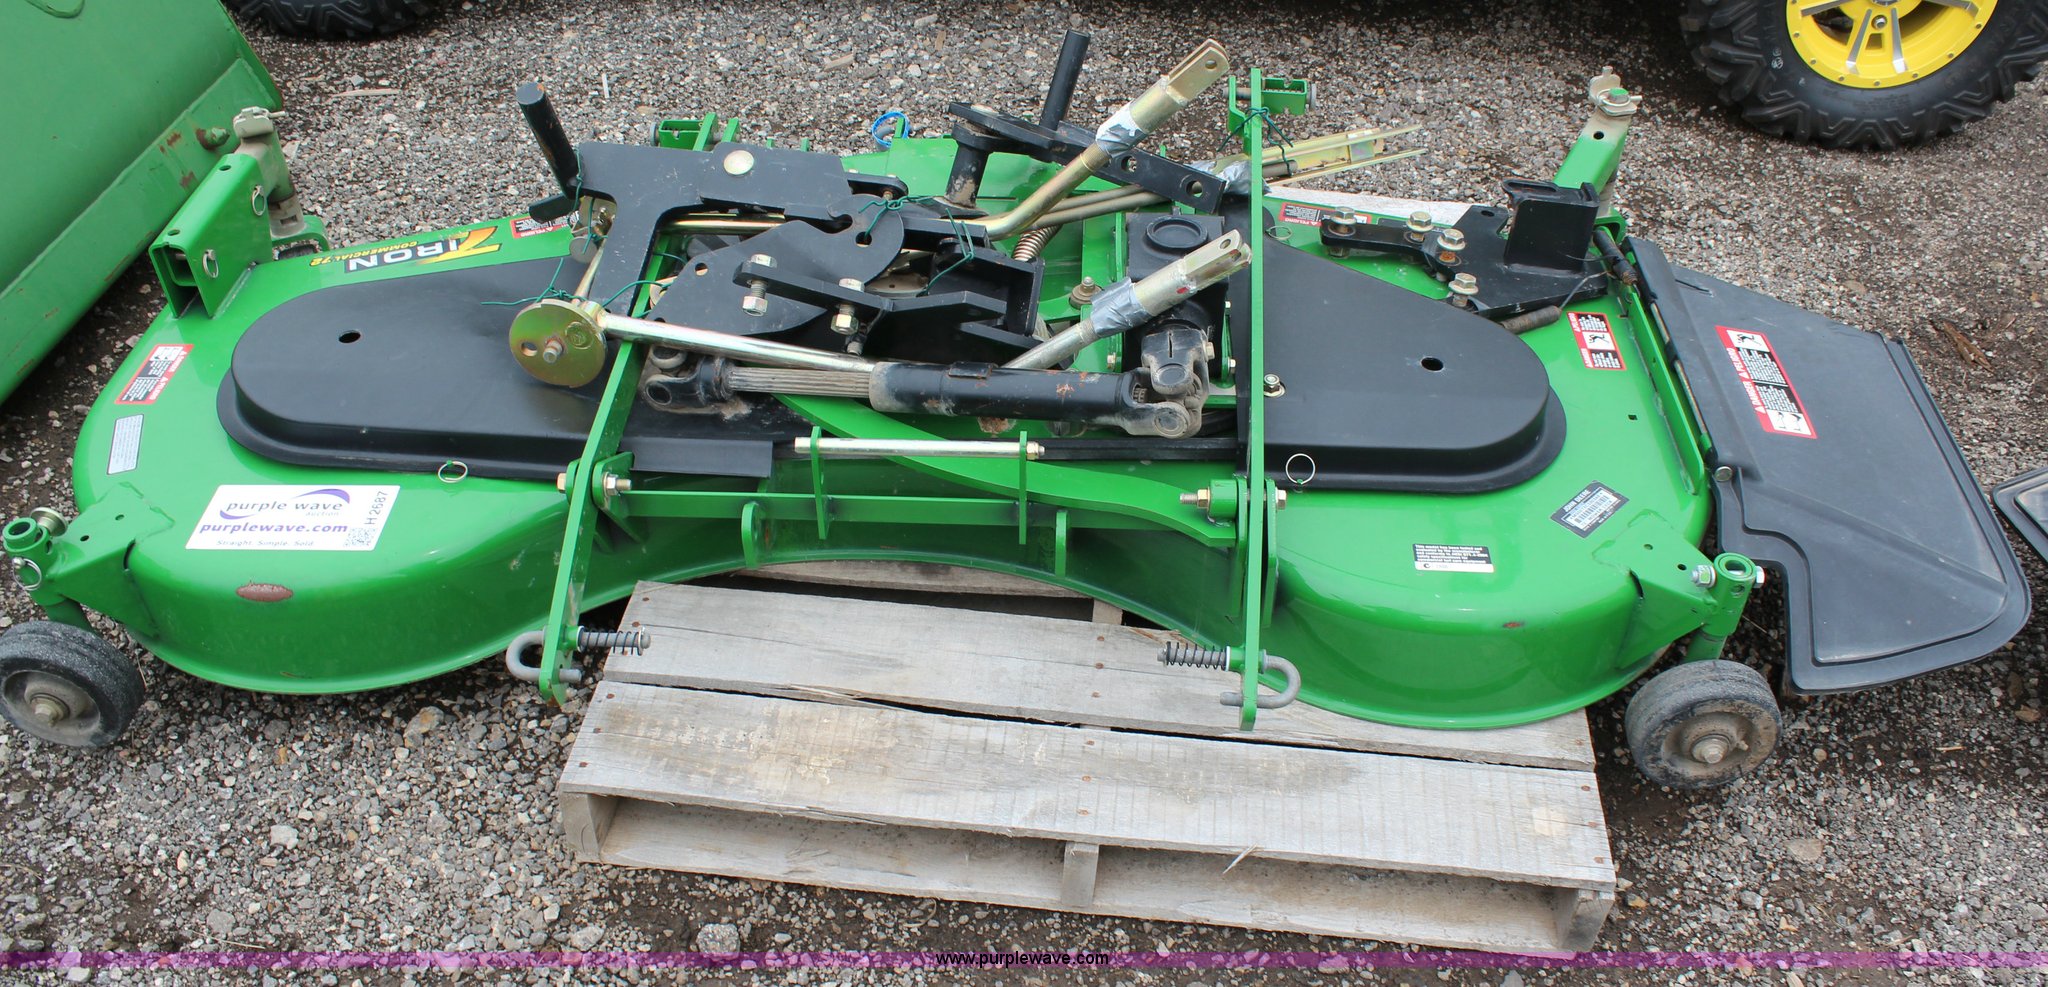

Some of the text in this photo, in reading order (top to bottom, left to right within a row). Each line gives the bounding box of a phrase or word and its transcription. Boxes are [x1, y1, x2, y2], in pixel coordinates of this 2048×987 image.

[335, 240, 418, 261] COMMERCIAL
[1575, 489, 1592, 503] DEERE
[227, 501, 343, 512] purple wave
[199, 522, 348, 534] purplewave.com
